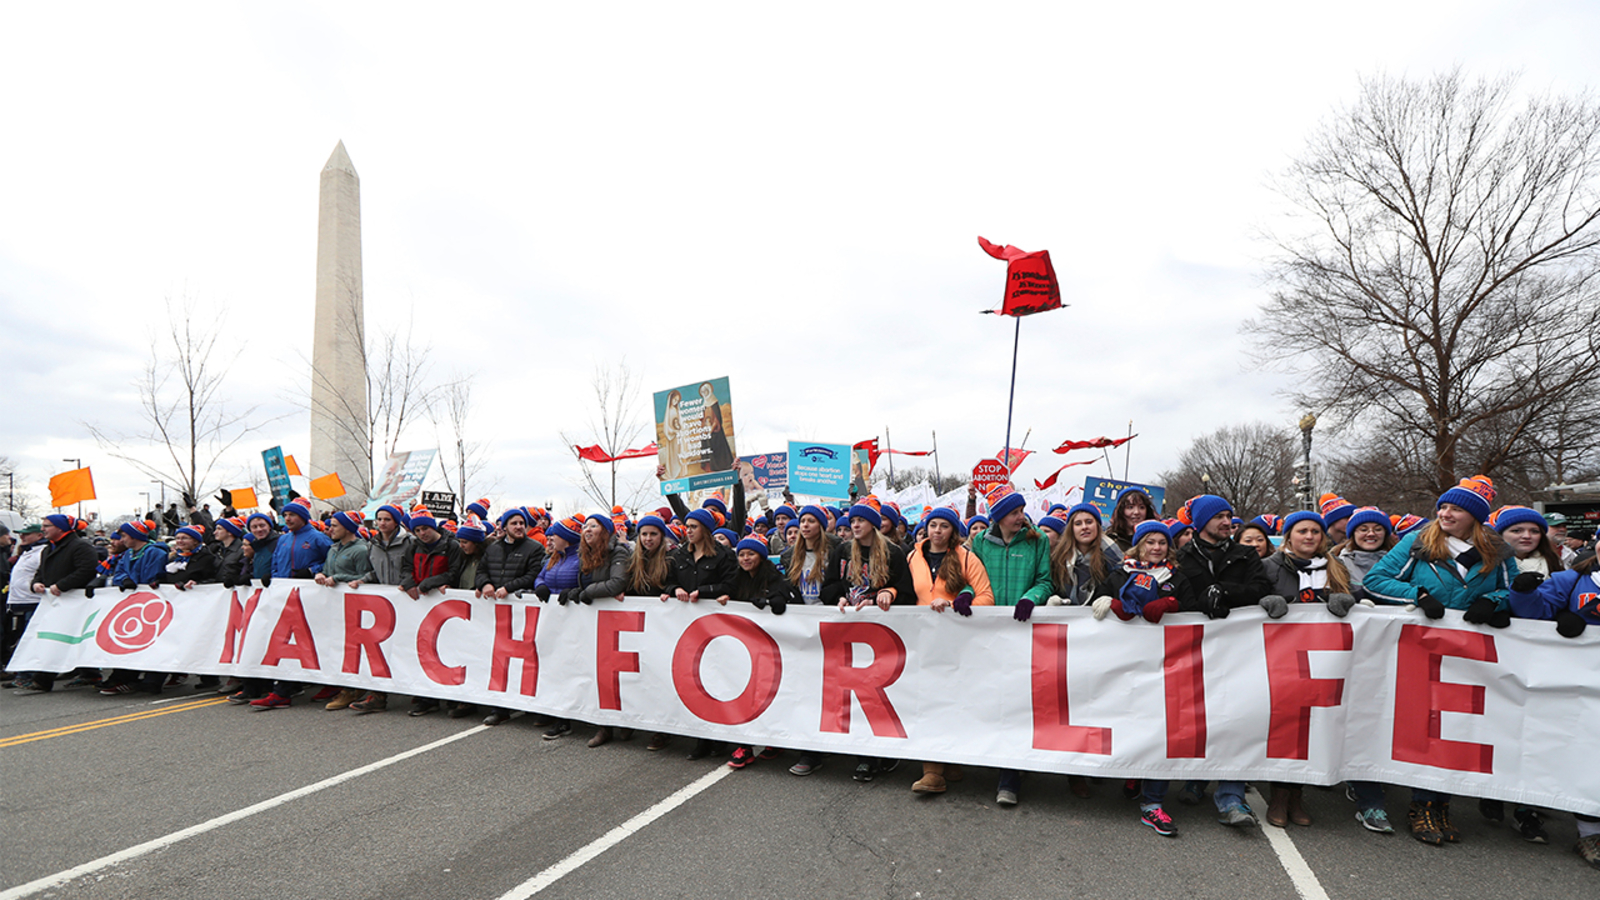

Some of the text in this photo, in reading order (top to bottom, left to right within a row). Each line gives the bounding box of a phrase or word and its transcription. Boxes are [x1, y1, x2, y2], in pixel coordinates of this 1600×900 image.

[680, 399, 703, 408] Fewer
[978, 464, 1002, 473] STOP
[973, 474, 1009, 482] ABORTION
[424, 492, 431, 500] I
[432, 492, 453, 502] AM
[218, 586, 1500, 775] MARCH FOR LIFE
